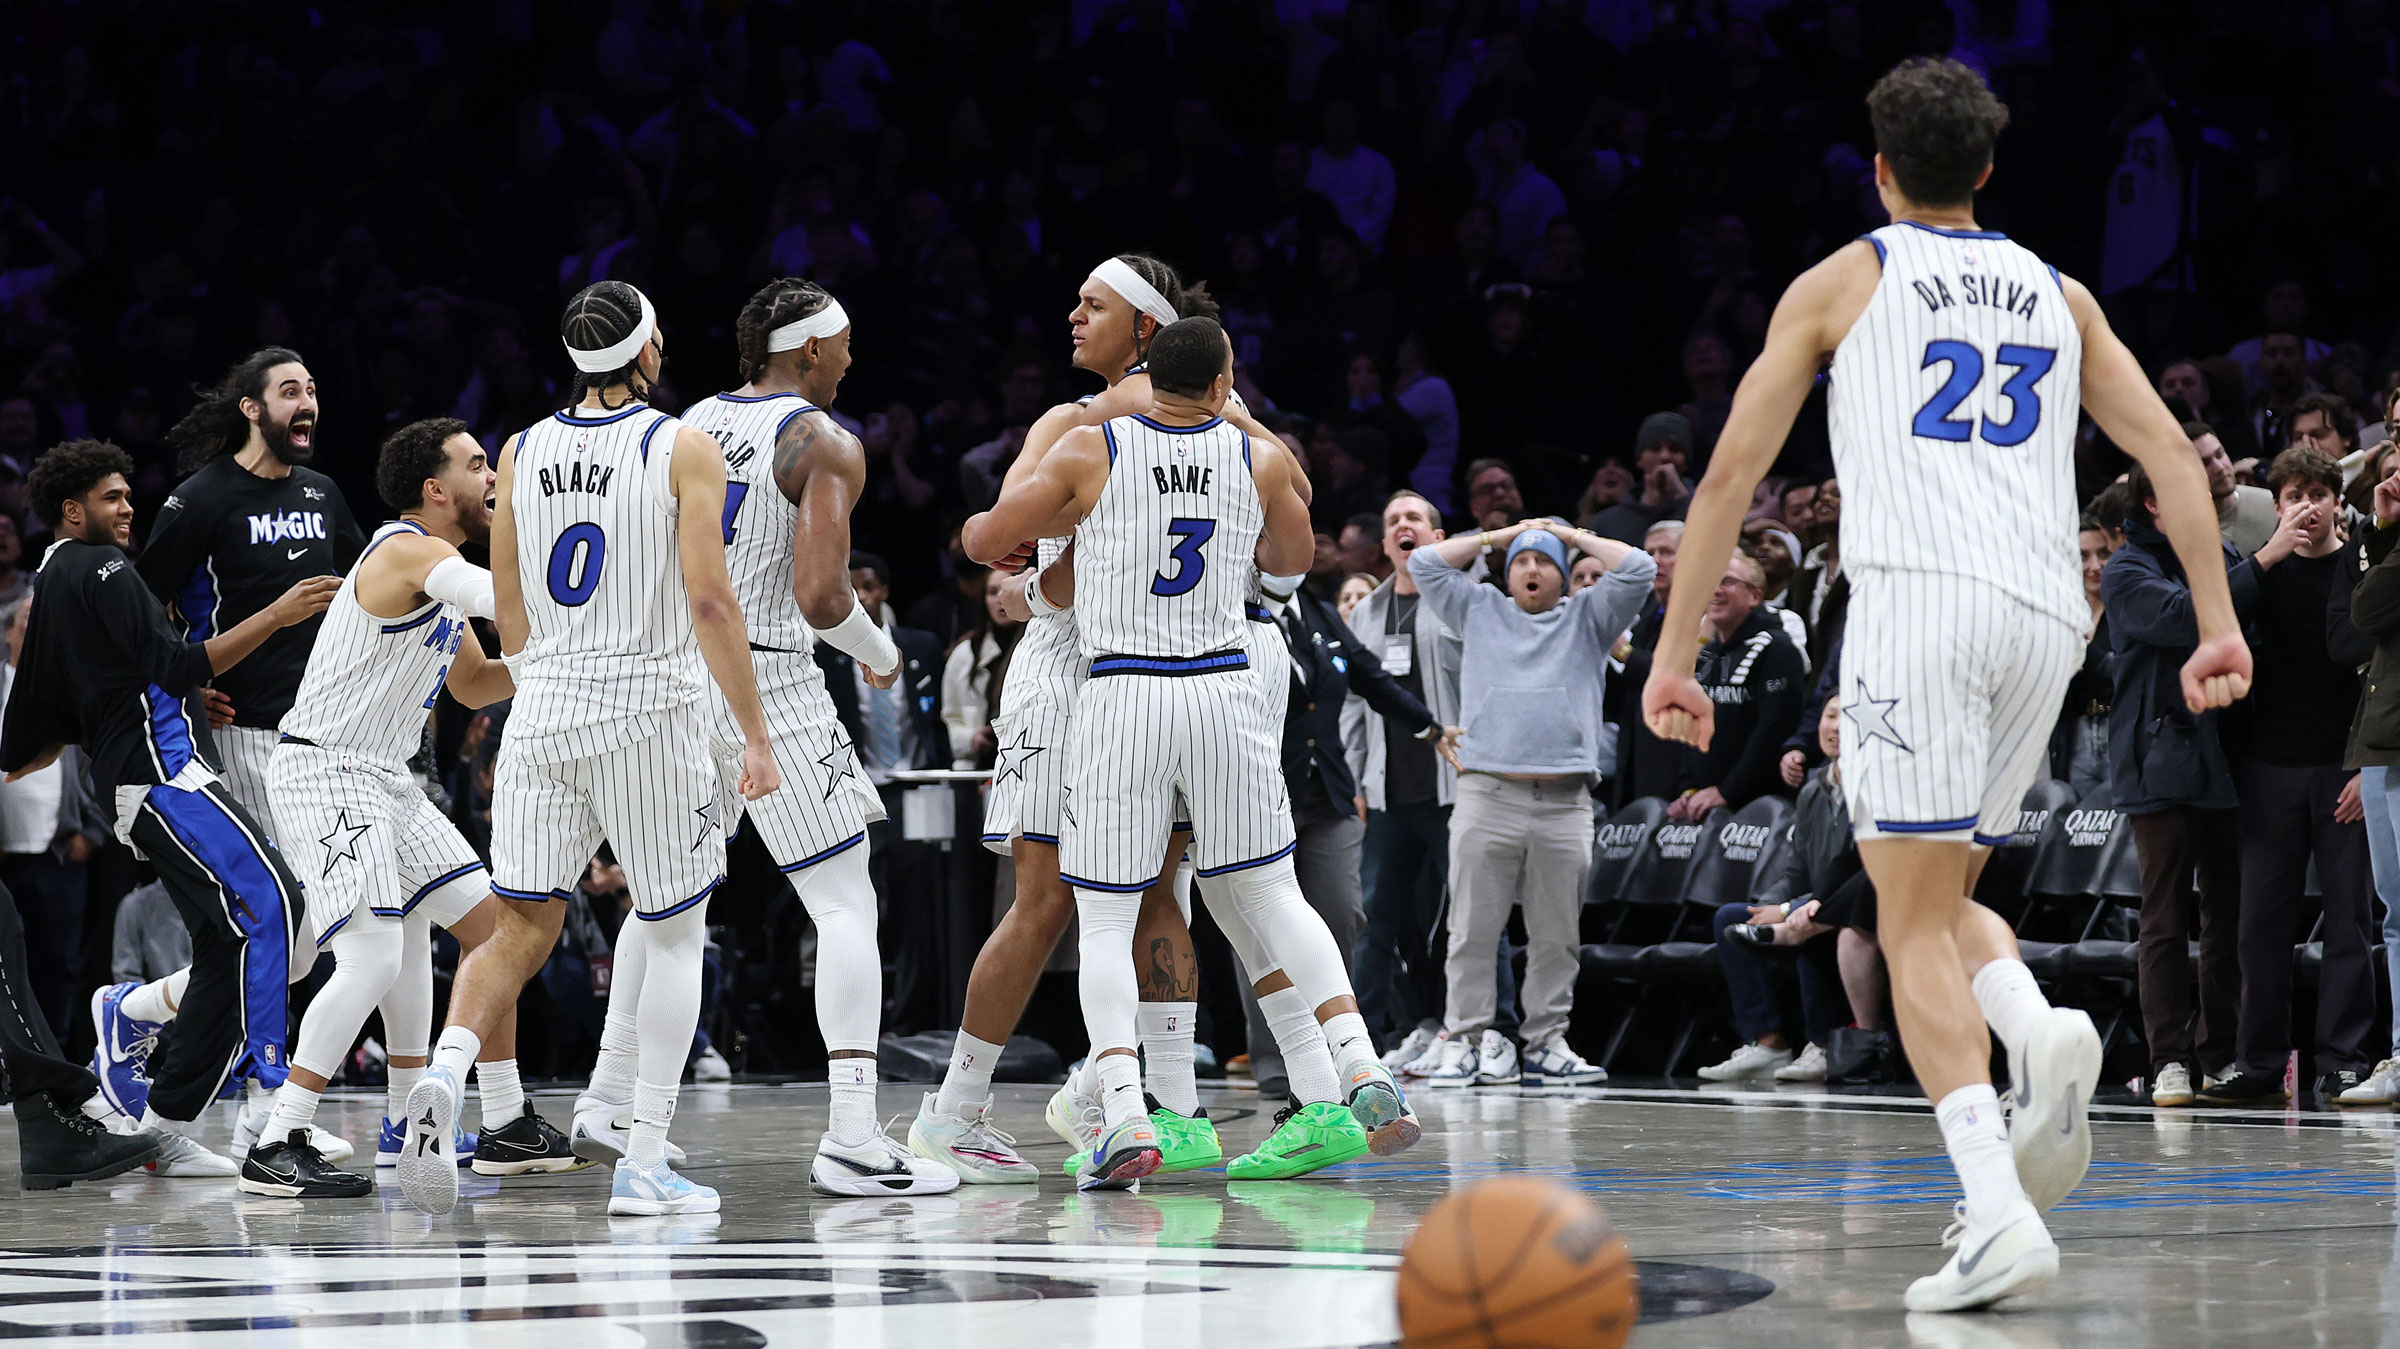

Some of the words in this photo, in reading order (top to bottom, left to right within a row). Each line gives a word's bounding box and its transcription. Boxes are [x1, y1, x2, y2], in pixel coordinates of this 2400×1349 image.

[1912, 275, 1957, 312] DA
[1962, 274, 2038, 321] SILVA
[1911, 338, 2059, 447] 23
[538, 461, 614, 498] BLACK
[1152, 464, 1213, 496] BANE
[546, 521, 606, 608] 0
[1149, 517, 1218, 598] 3
[1719, 822, 1770, 849] QATAR
[2064, 809, 2118, 836] QATAR
